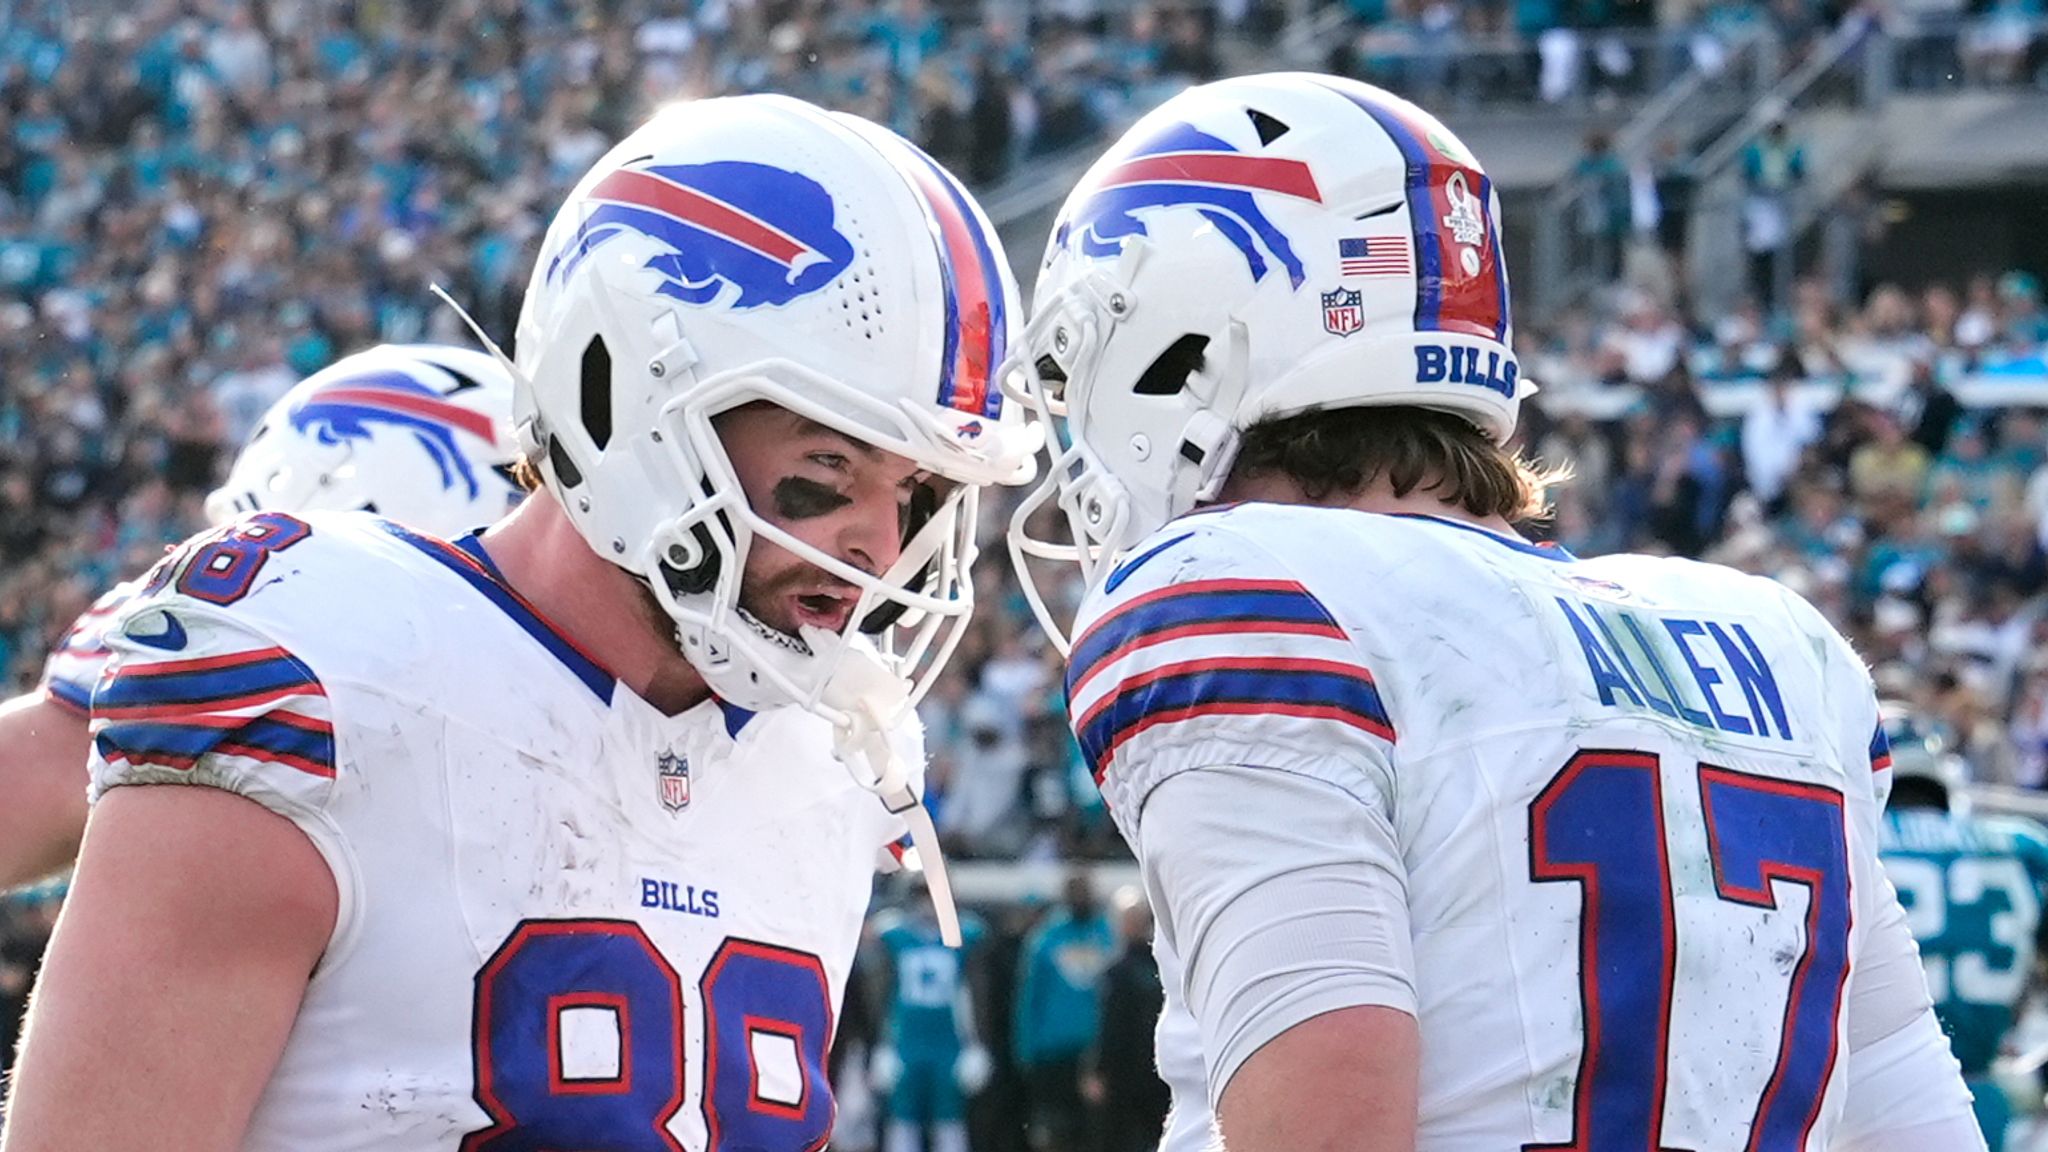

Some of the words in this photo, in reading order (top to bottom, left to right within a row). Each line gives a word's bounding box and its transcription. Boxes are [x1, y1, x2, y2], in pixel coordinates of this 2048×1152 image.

[1327, 307, 1361, 332] NFL
[1414, 345, 1518, 399] BILLS
[1554, 596, 1793, 741] ALLEN
[663, 778, 689, 804] NFL
[641, 878, 720, 918] BILLS
[1521, 747, 1853, 1152] 17
[459, 918, 837, 1152] 88
